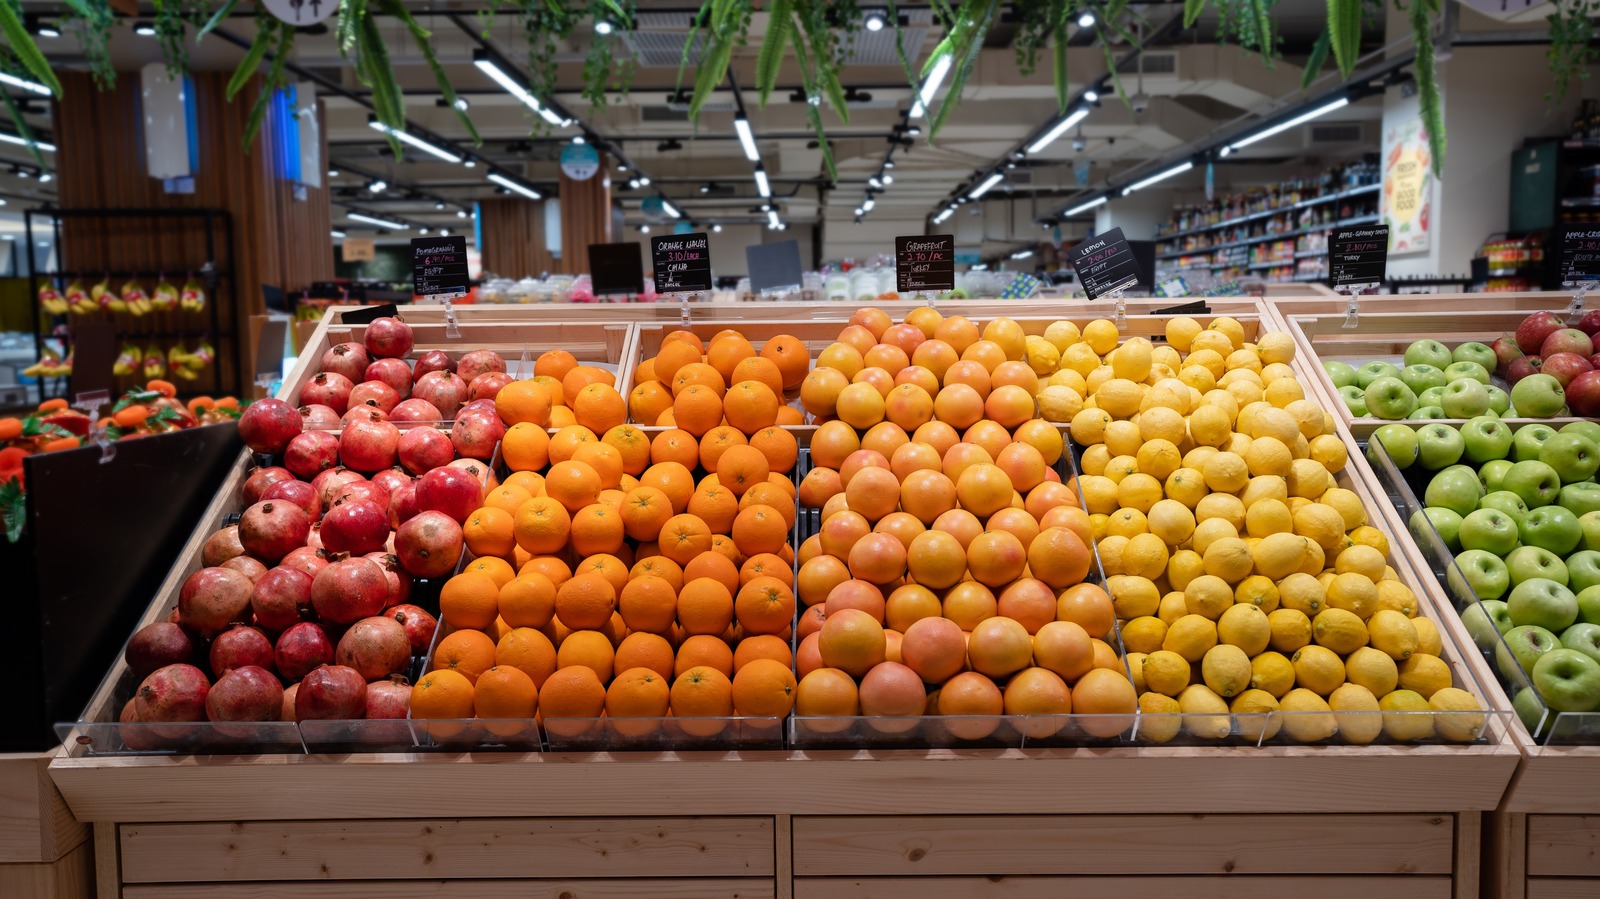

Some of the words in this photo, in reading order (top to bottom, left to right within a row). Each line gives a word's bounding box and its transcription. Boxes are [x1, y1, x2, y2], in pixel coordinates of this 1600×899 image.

[658, 241, 684, 251] ORANGE
[685, 239, 707, 249] NAVEL
[905, 240, 948, 252] GRAPEFRUIT
[1080, 239, 1106, 256] LEMON
[667, 262, 688, 272] CHINA
[909, 261, 930, 273] TURKEY
